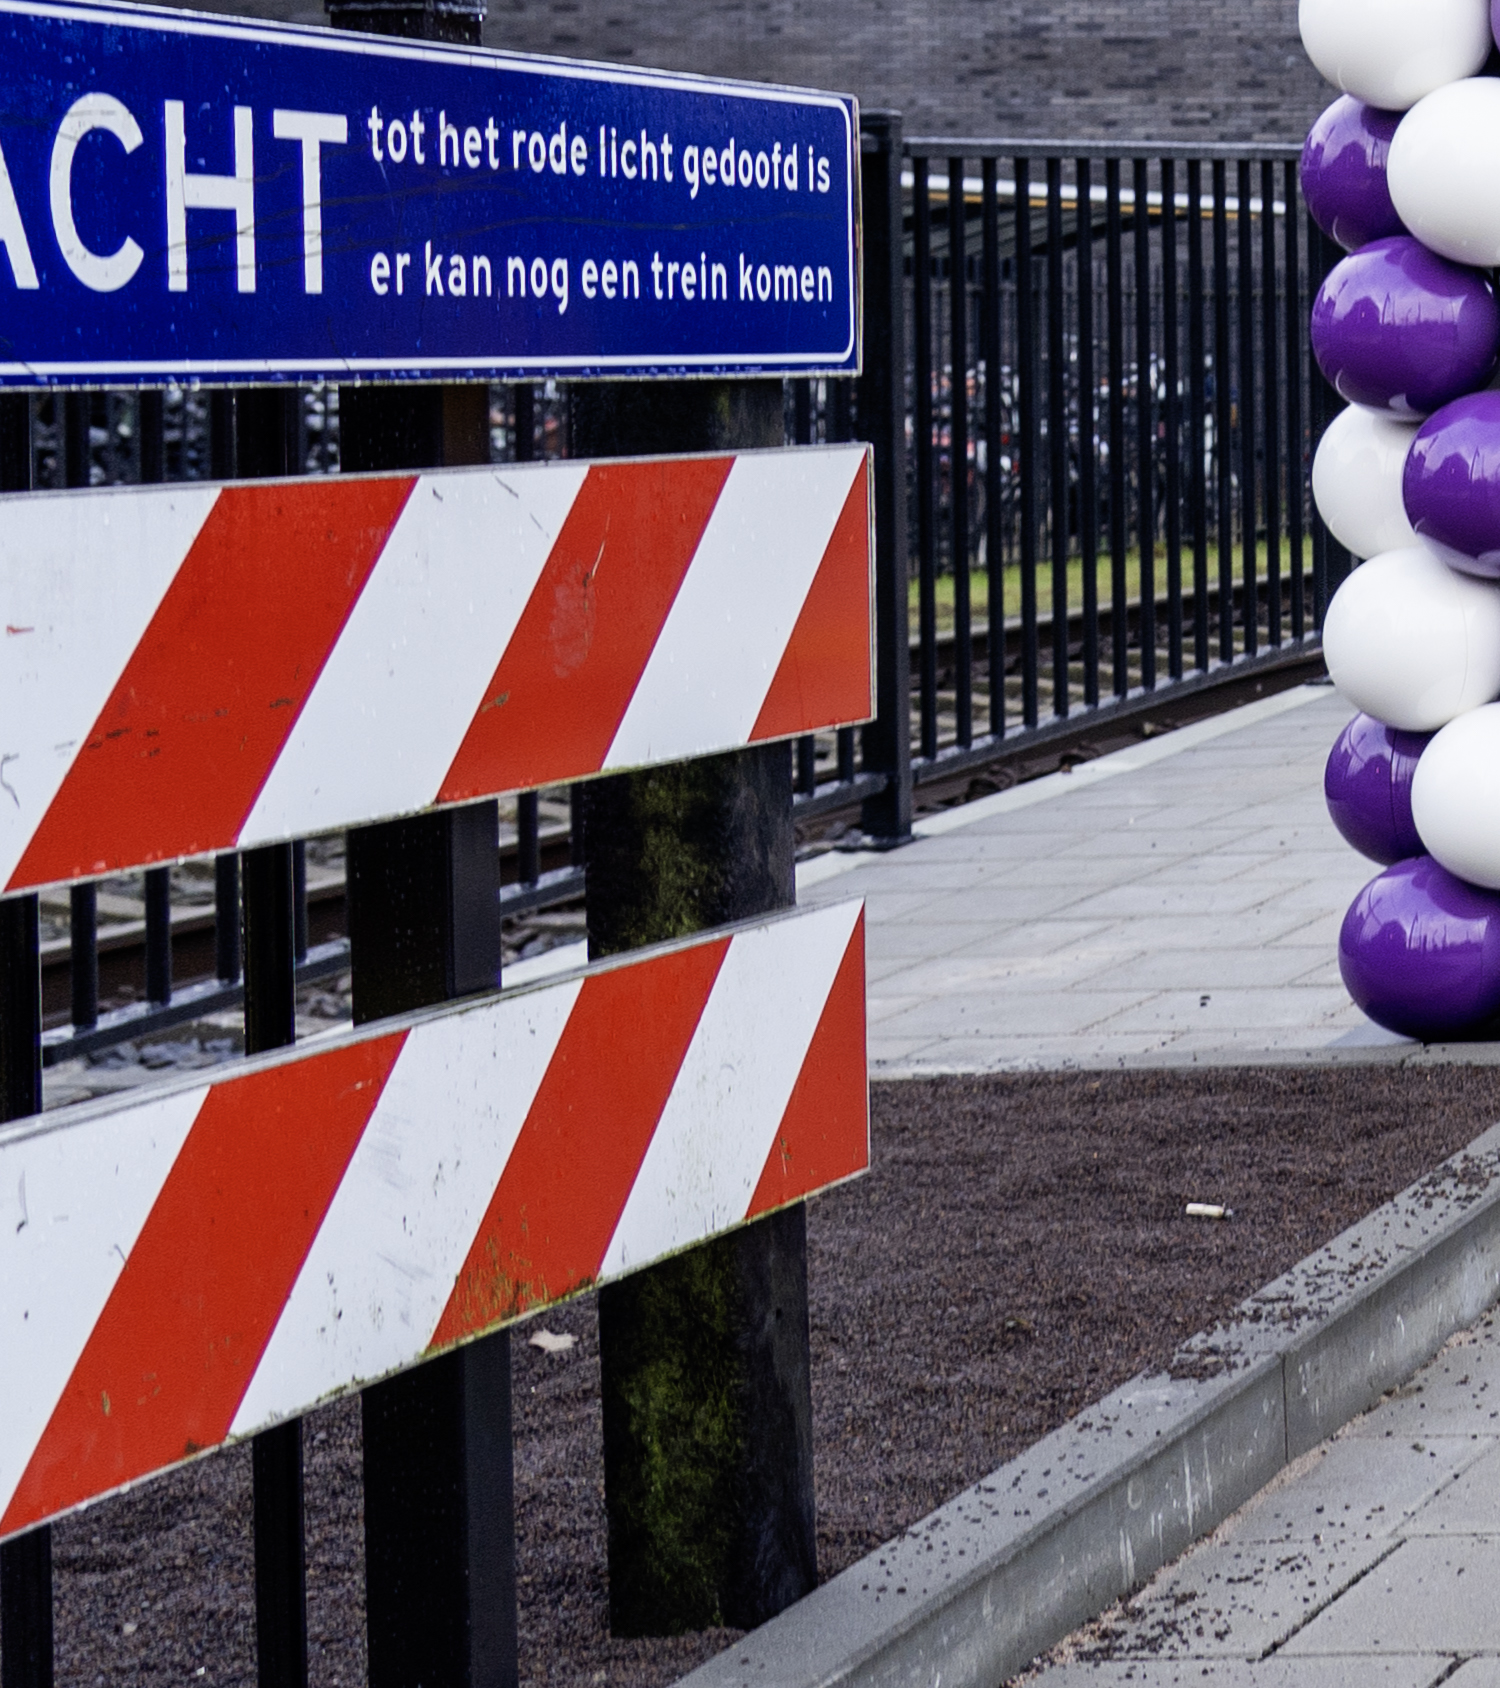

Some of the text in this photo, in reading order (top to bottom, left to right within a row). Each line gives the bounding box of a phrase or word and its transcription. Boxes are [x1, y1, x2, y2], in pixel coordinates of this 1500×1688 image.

[368, 105, 425, 164] tot
[439, 110, 500, 170] het
[512, 121, 588, 175] rode
[599, 125, 673, 182] licht
[683, 137, 798, 200] gedoofd
[807, 145, 831, 193] is
[370, 240, 833, 315] er kan nog een trein komen
